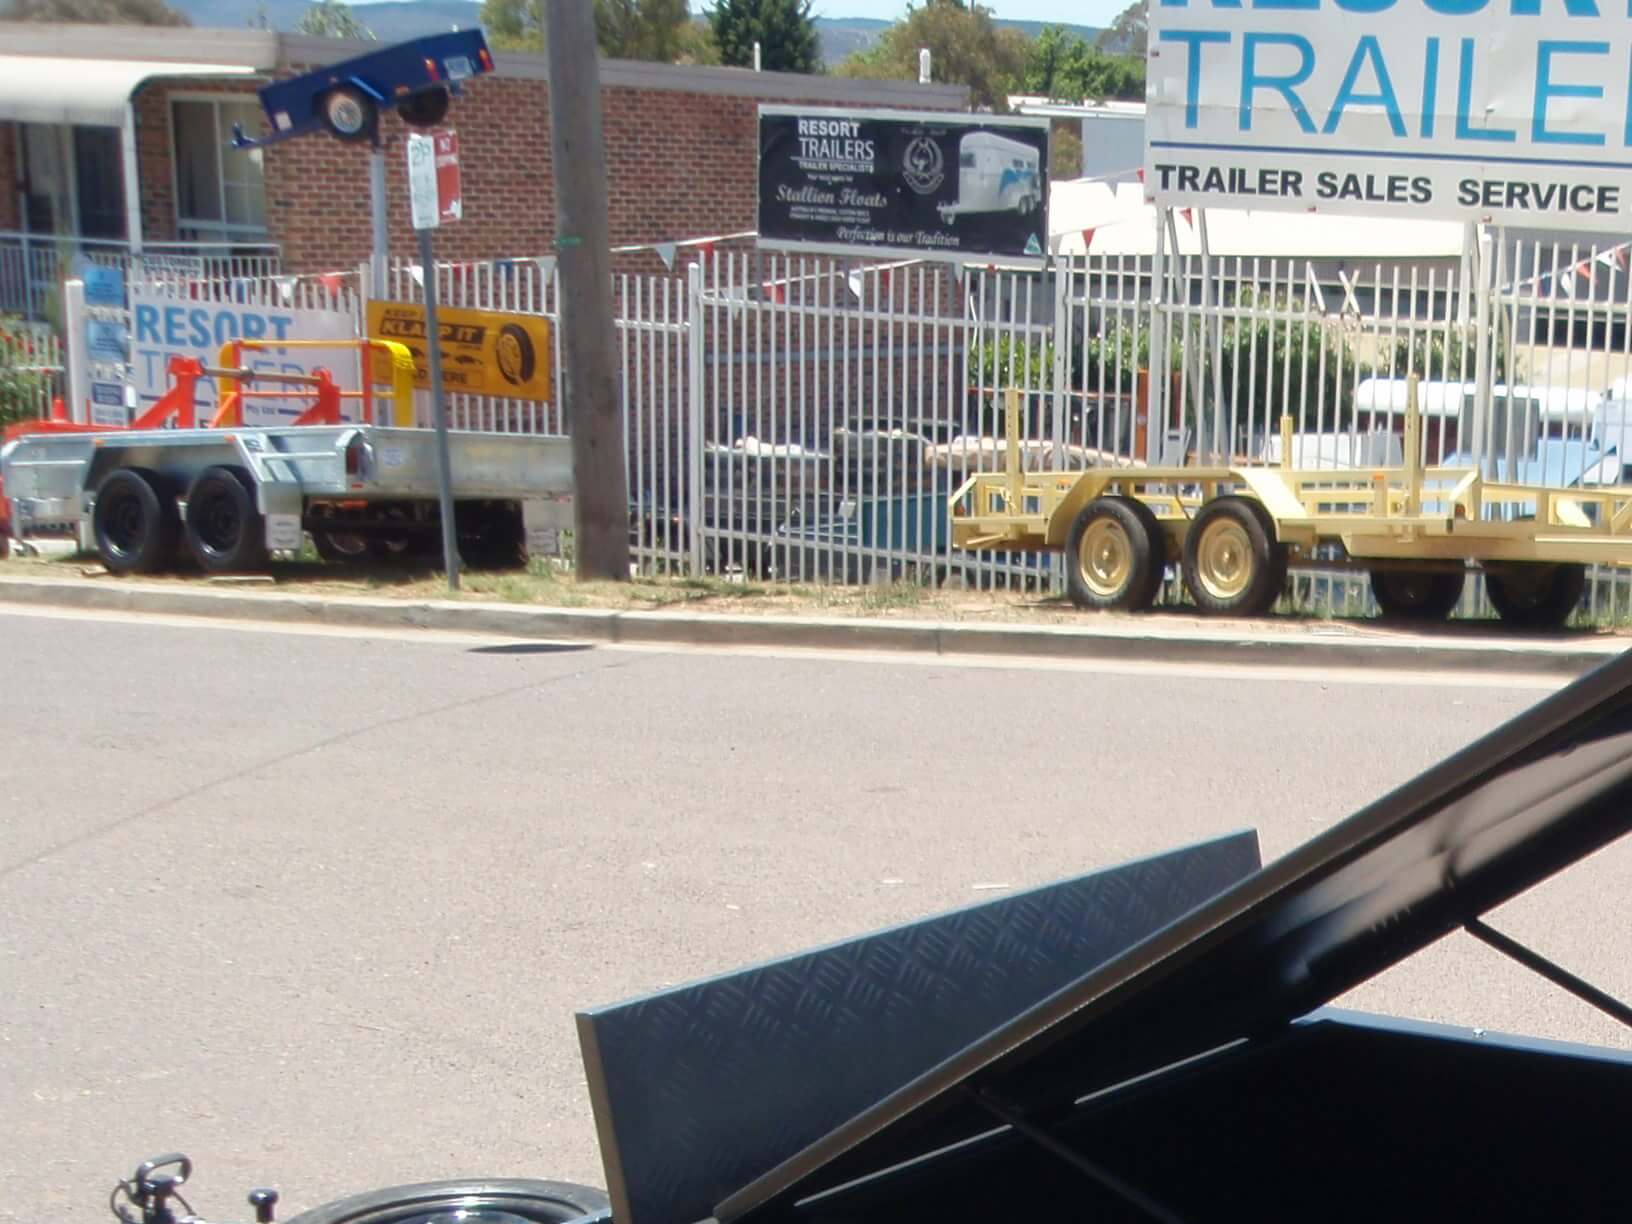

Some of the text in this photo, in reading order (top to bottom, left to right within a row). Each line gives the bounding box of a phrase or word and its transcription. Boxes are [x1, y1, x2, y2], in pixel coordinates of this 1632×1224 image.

[798, 119, 861, 137] RESORT
[798, 137, 875, 161] TRAILERS
[799, 160, 828, 171] TRAILER
[776, 184, 888, 208] Stallion Floats
[1154, 163, 1303, 198] TRAILER
[1316, 171, 1433, 204] SALES
[1457, 178, 1619, 214] SERVICE
[836, 226, 960, 246] Perfection is our Tradition
[381, 319, 478, 342] KLAP IT
